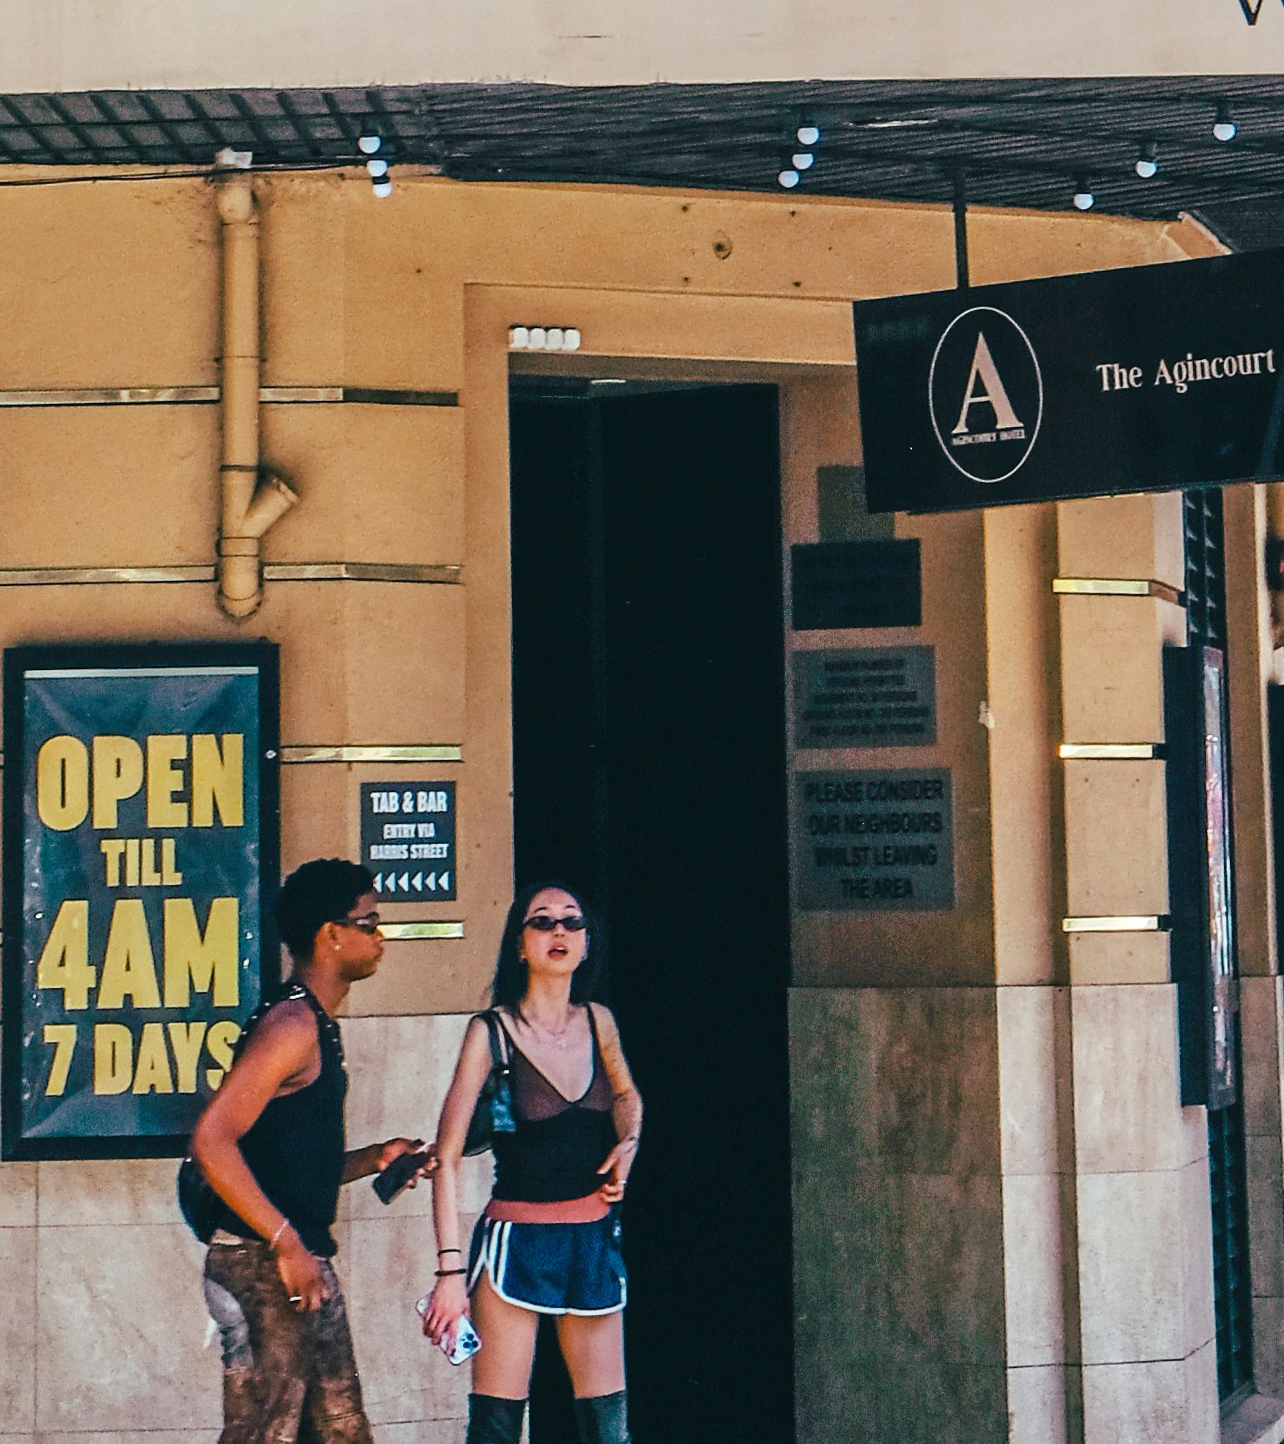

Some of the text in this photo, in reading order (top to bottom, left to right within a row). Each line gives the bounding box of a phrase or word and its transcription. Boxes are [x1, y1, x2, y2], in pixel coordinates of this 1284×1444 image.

[951, 330, 1025, 435] A
[1096, 363, 1142, 392] The
[1154, 348, 1275, 393] Agincourt
[36, 733, 244, 832] OPEN
[805, 778, 943, 803] PLEASE CONSIDER
[370, 791, 447, 813] TAB & BAR
[417, 822, 435, 838] VIA
[844, 812, 943, 834] NEIGHBOURS
[100, 838, 183, 888] TILL
[370, 843, 449, 860] HARRIS STREET
[873, 845, 938, 866] LEAVING
[840, 877, 914, 899] THE AREA
[37, 897, 239, 1011] 4AM
[43, 1022, 240, 1097] 7 DAYS
